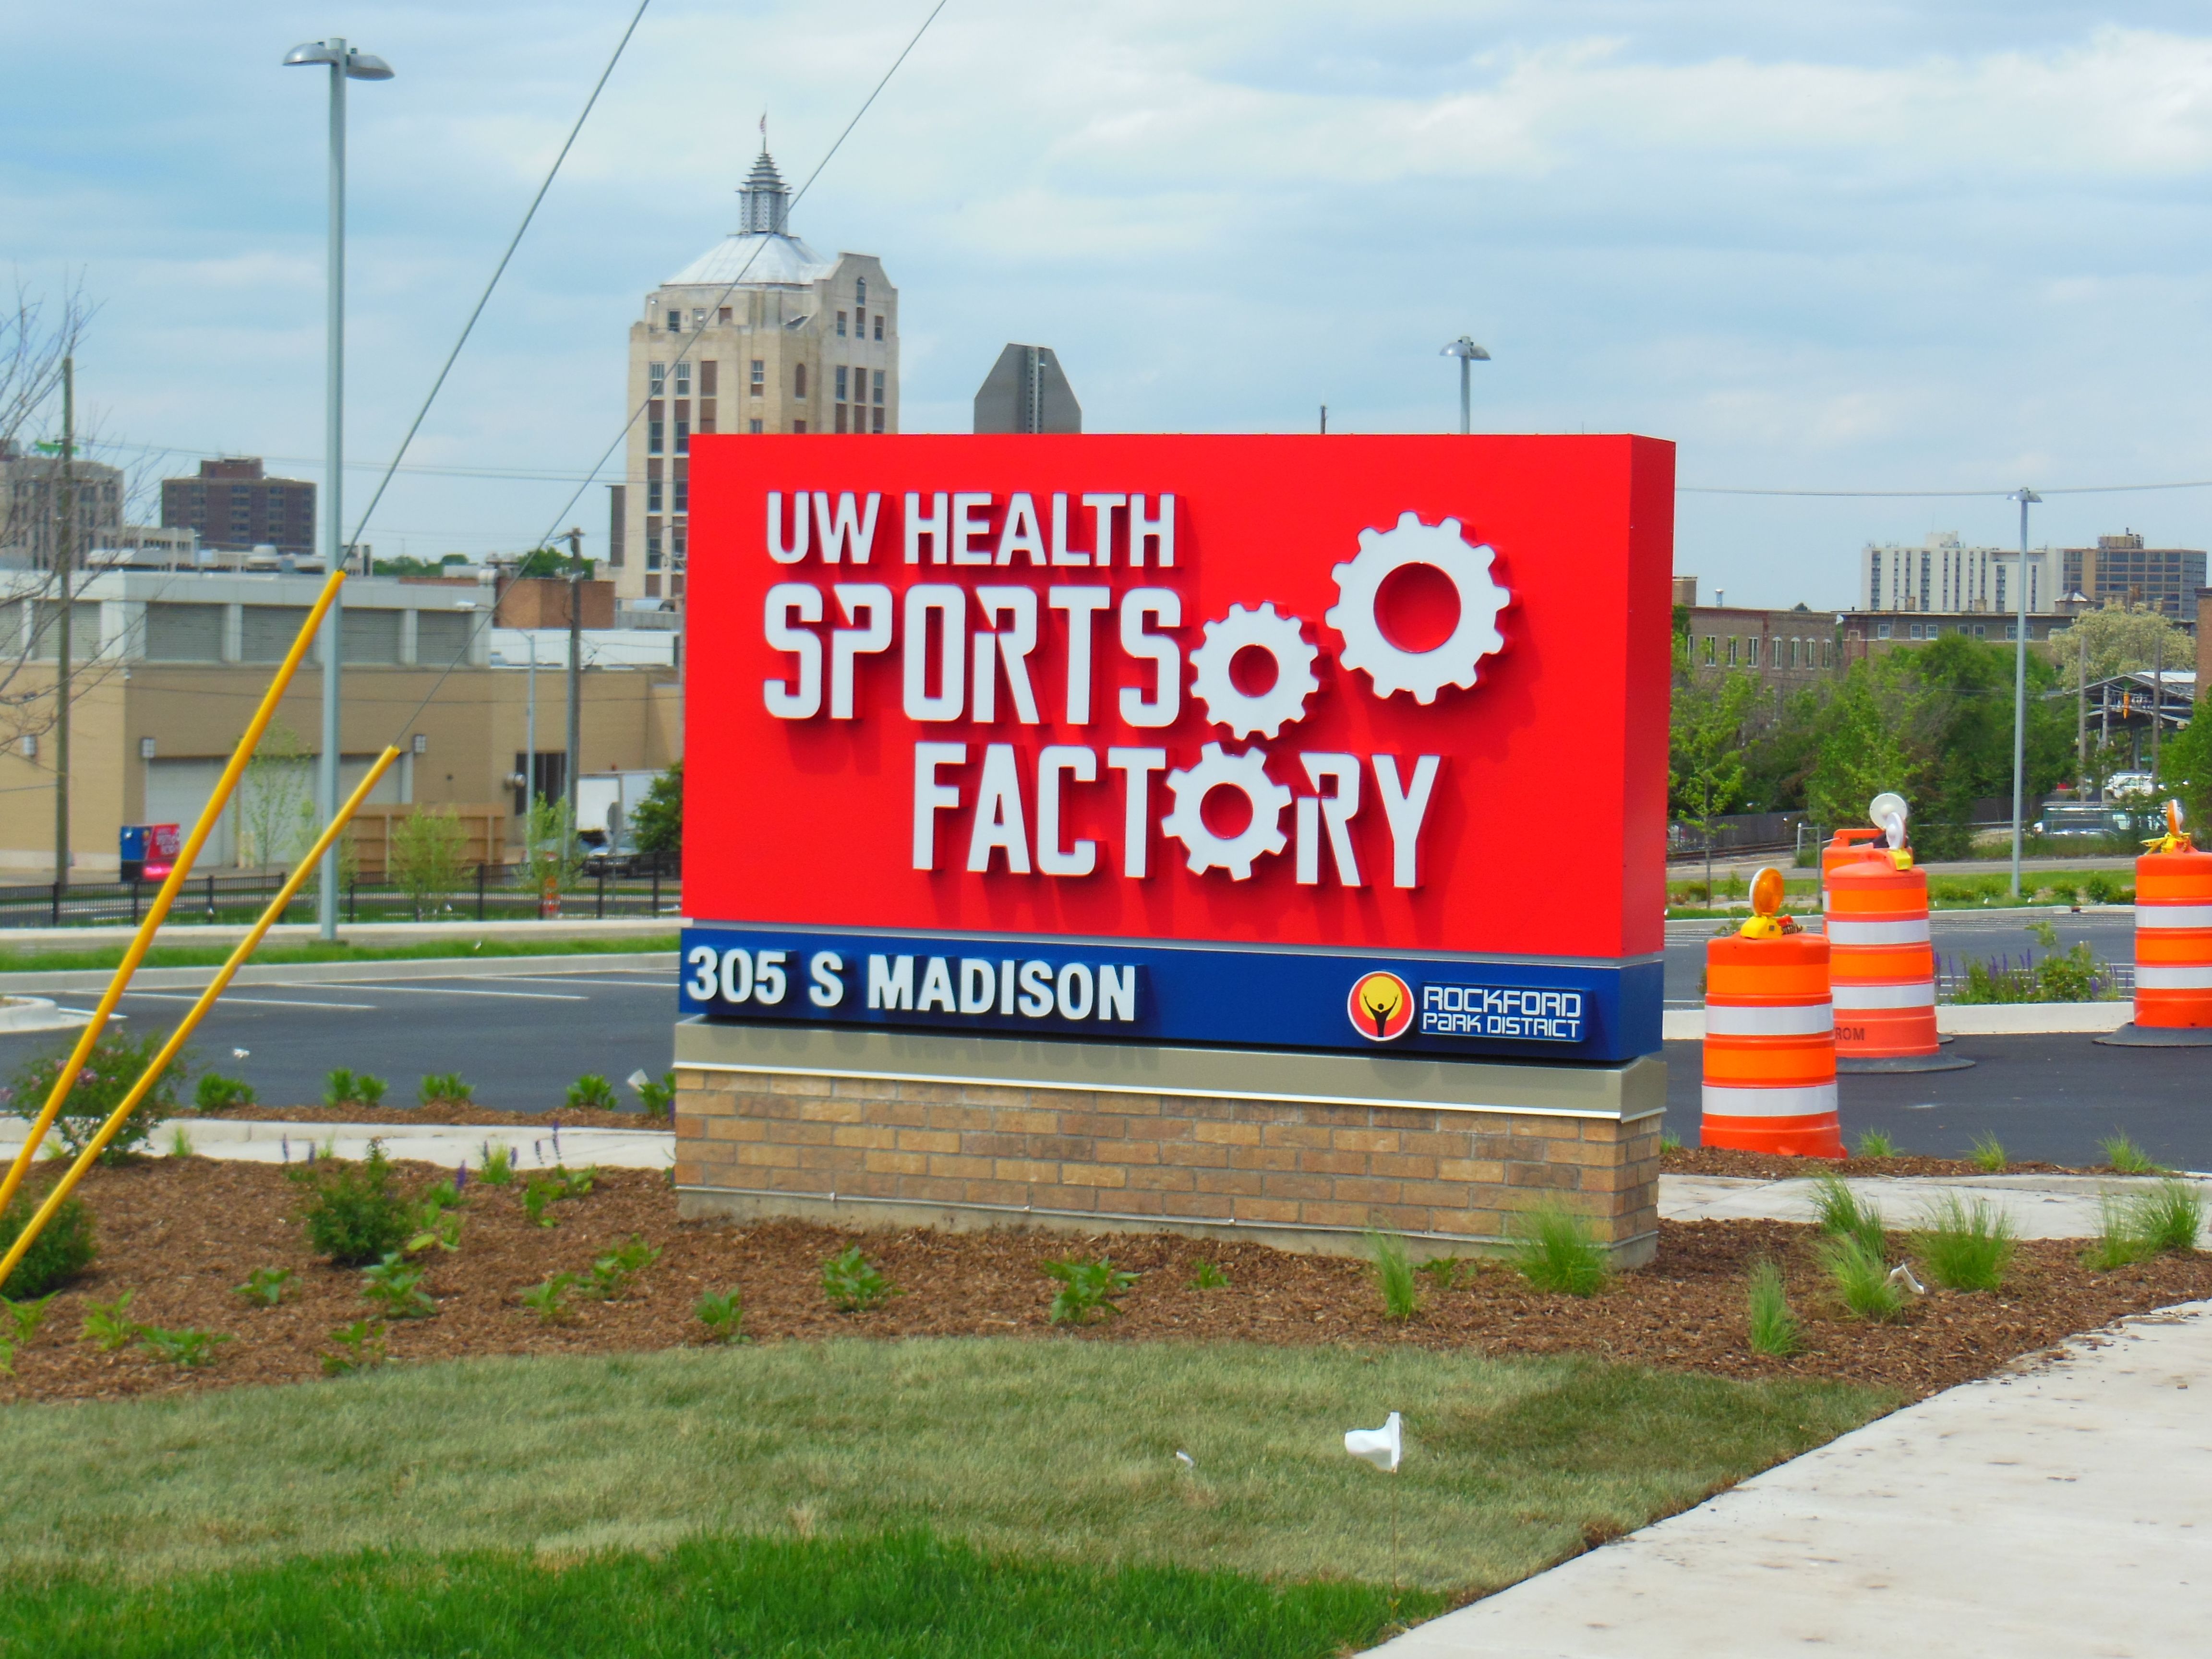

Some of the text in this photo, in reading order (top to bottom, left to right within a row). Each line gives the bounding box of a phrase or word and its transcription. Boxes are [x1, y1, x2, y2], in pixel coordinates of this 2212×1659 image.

[768, 492, 1175, 567] UW HEALTH
[763, 583, 1181, 727] SPORTS
[913, 741, 1441, 888] FACTORY
[686, 947, 1136, 1022] 305 S MADISON
[1423, 986, 1581, 1017] ROCKFORD
[1487, 1015, 1581, 1038] DISTRICT
